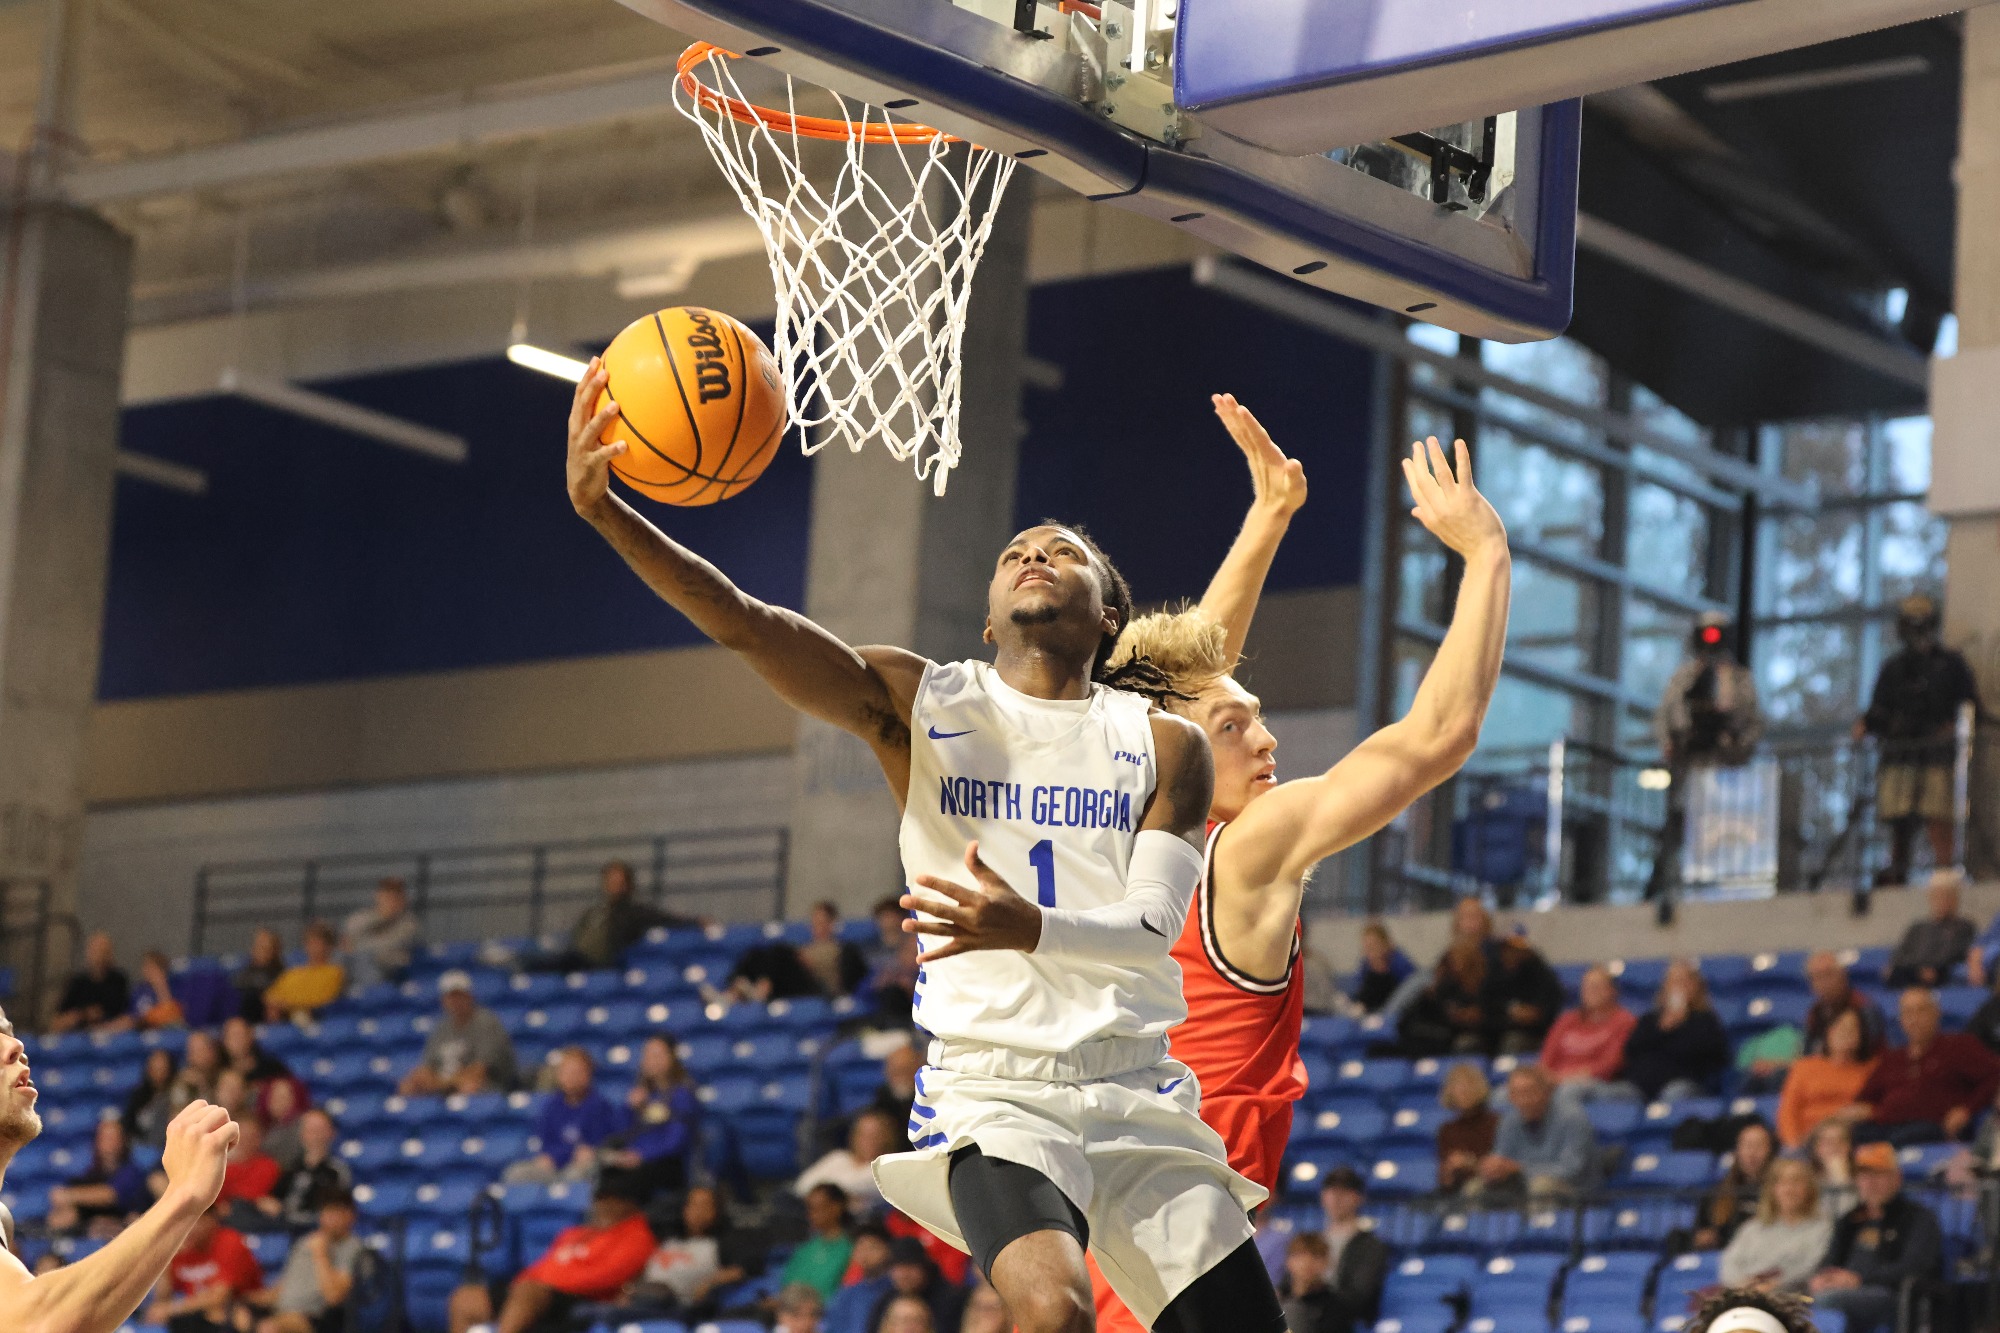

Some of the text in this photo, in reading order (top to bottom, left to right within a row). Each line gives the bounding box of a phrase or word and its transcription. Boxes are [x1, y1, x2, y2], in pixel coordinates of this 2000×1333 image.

[1114, 750, 1147, 766] PBC
[940, 776, 1131, 833] NORTH GEORGIA
[1029, 839, 1056, 908] 1
